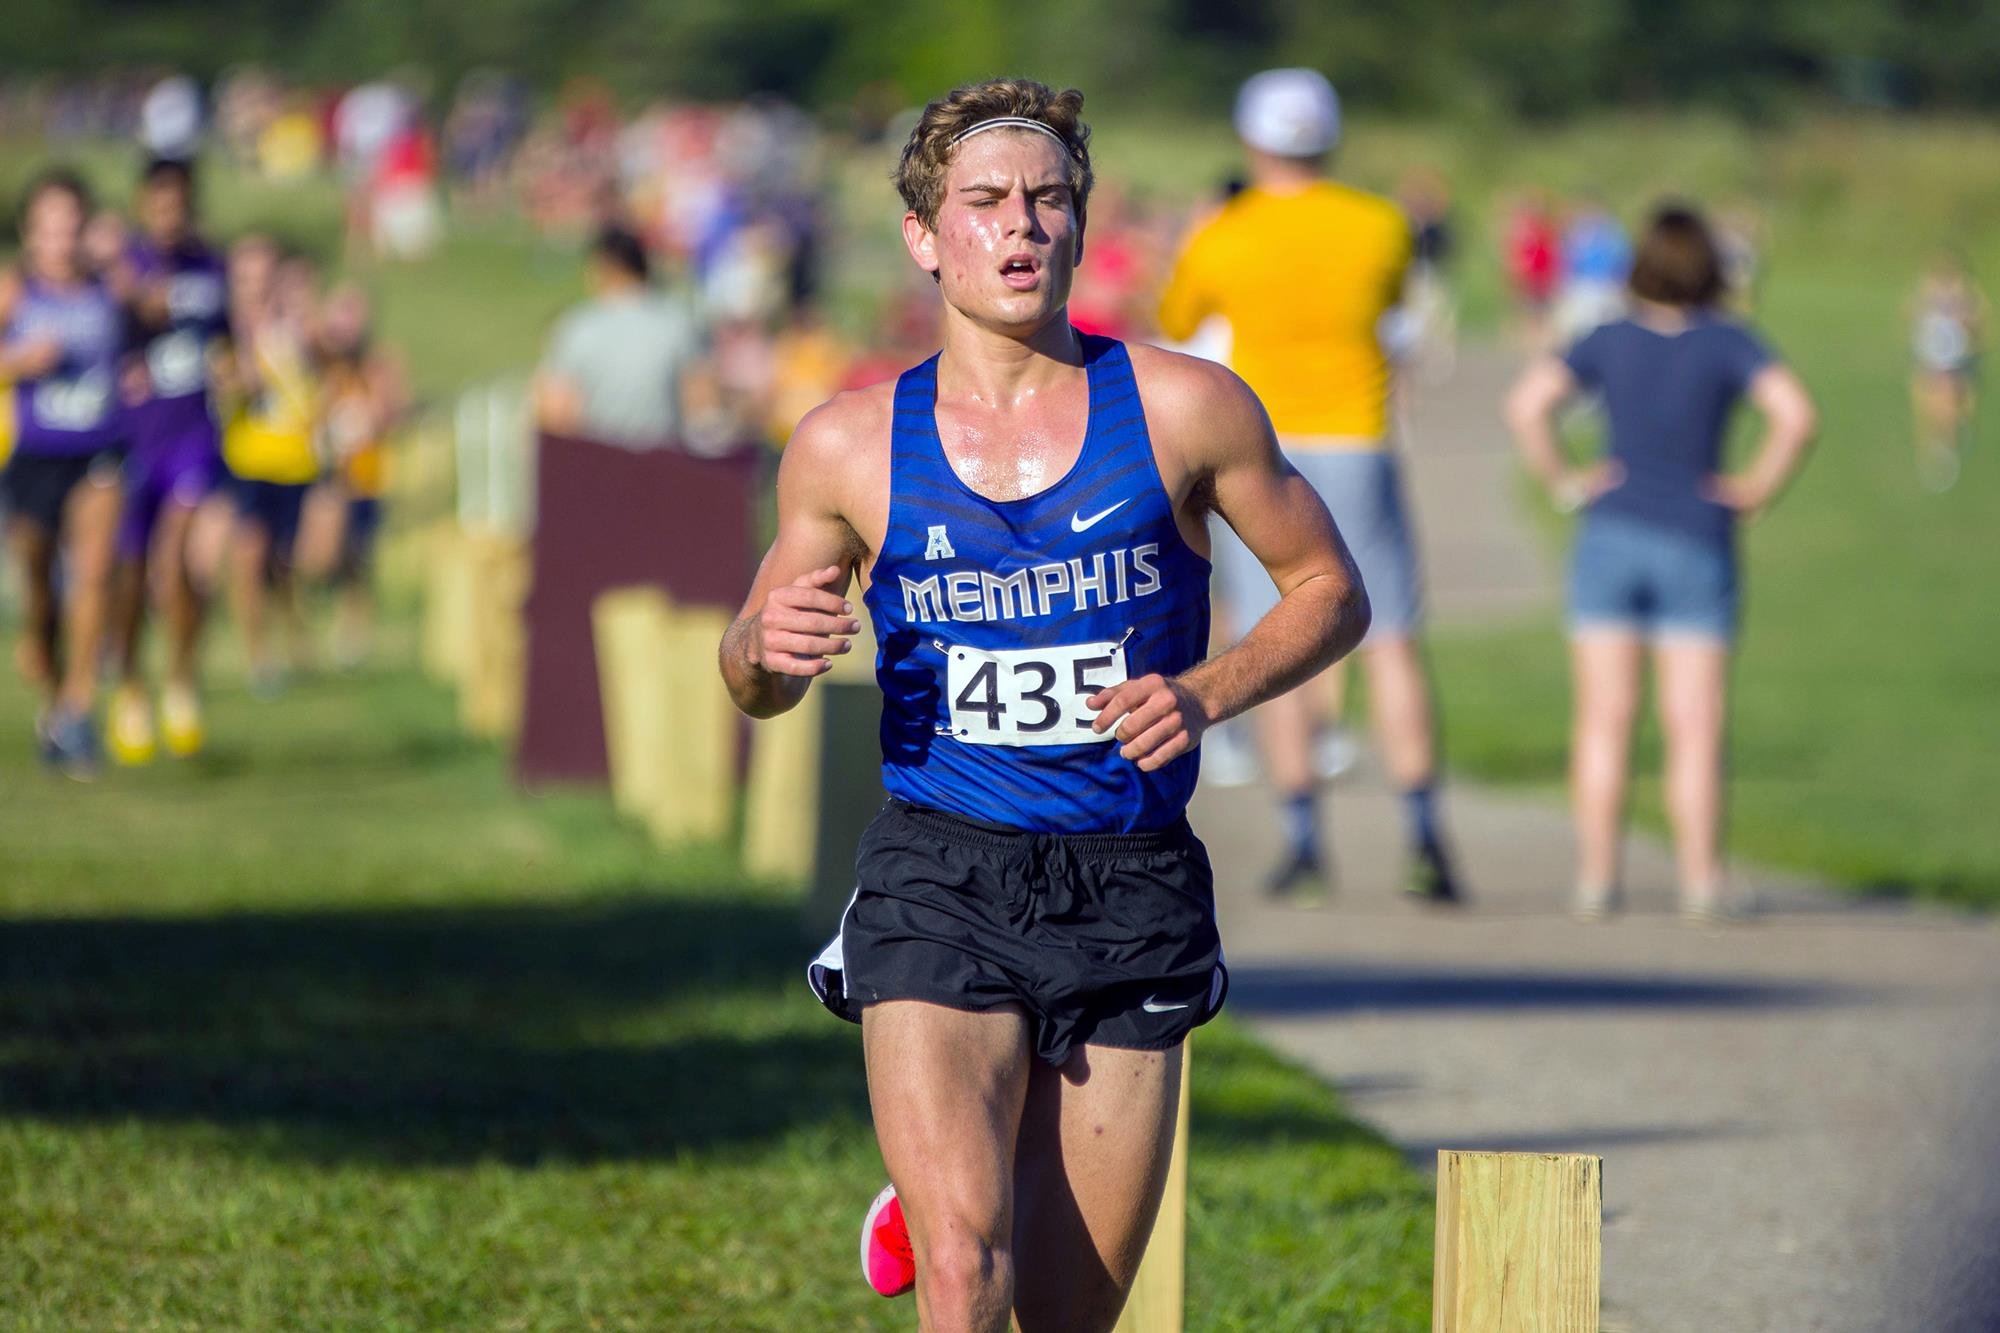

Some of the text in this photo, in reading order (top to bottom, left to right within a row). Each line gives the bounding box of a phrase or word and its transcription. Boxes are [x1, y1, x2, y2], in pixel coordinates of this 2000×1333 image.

[924, 525, 955, 560] A
[898, 543, 1162, 622] MEMPHIS
[955, 655, 1114, 732] 435
